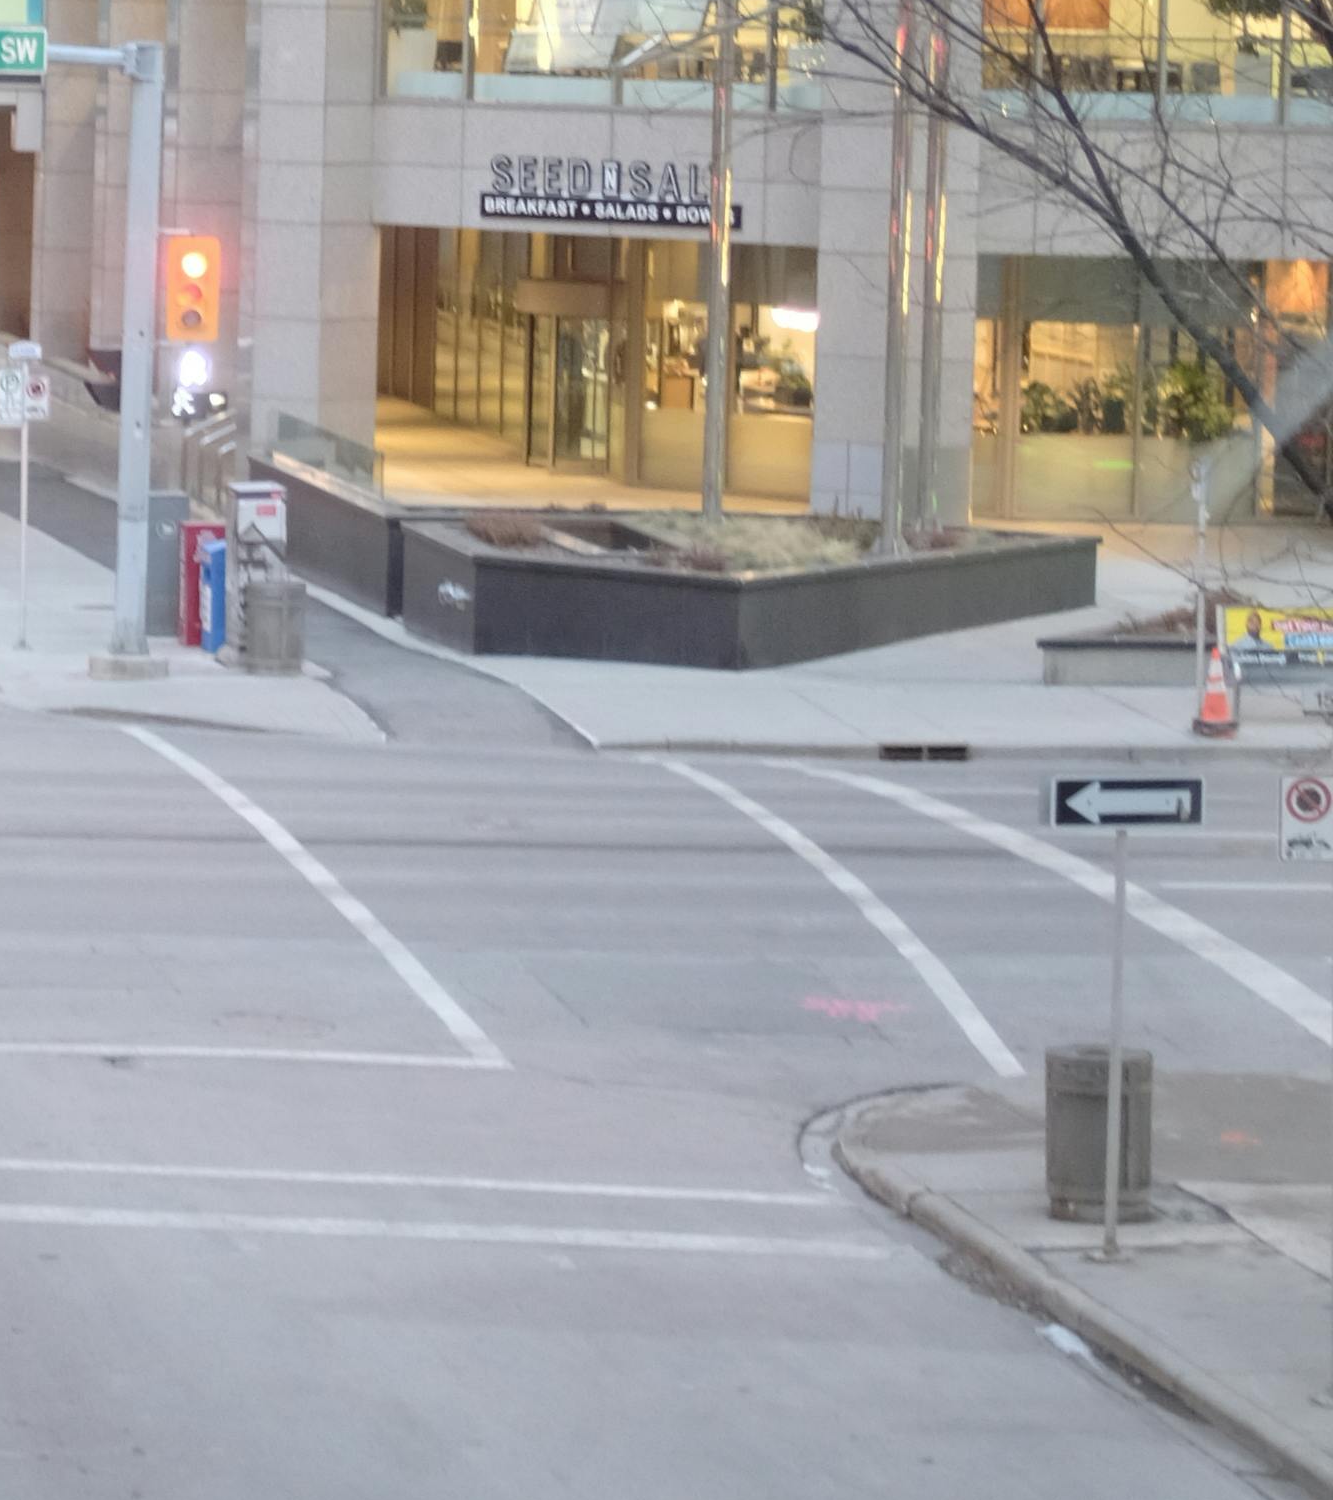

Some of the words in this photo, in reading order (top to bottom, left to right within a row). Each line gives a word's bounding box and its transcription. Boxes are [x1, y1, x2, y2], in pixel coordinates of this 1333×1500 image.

[0, 36, 38, 65] SW
[490, 154, 592, 198] SEED
[602, 160, 621, 200] N
[629, 160, 715, 205] SAL
[483, 195, 578, 219] BREAKFAST
[594, 201, 659, 222] SALADS
